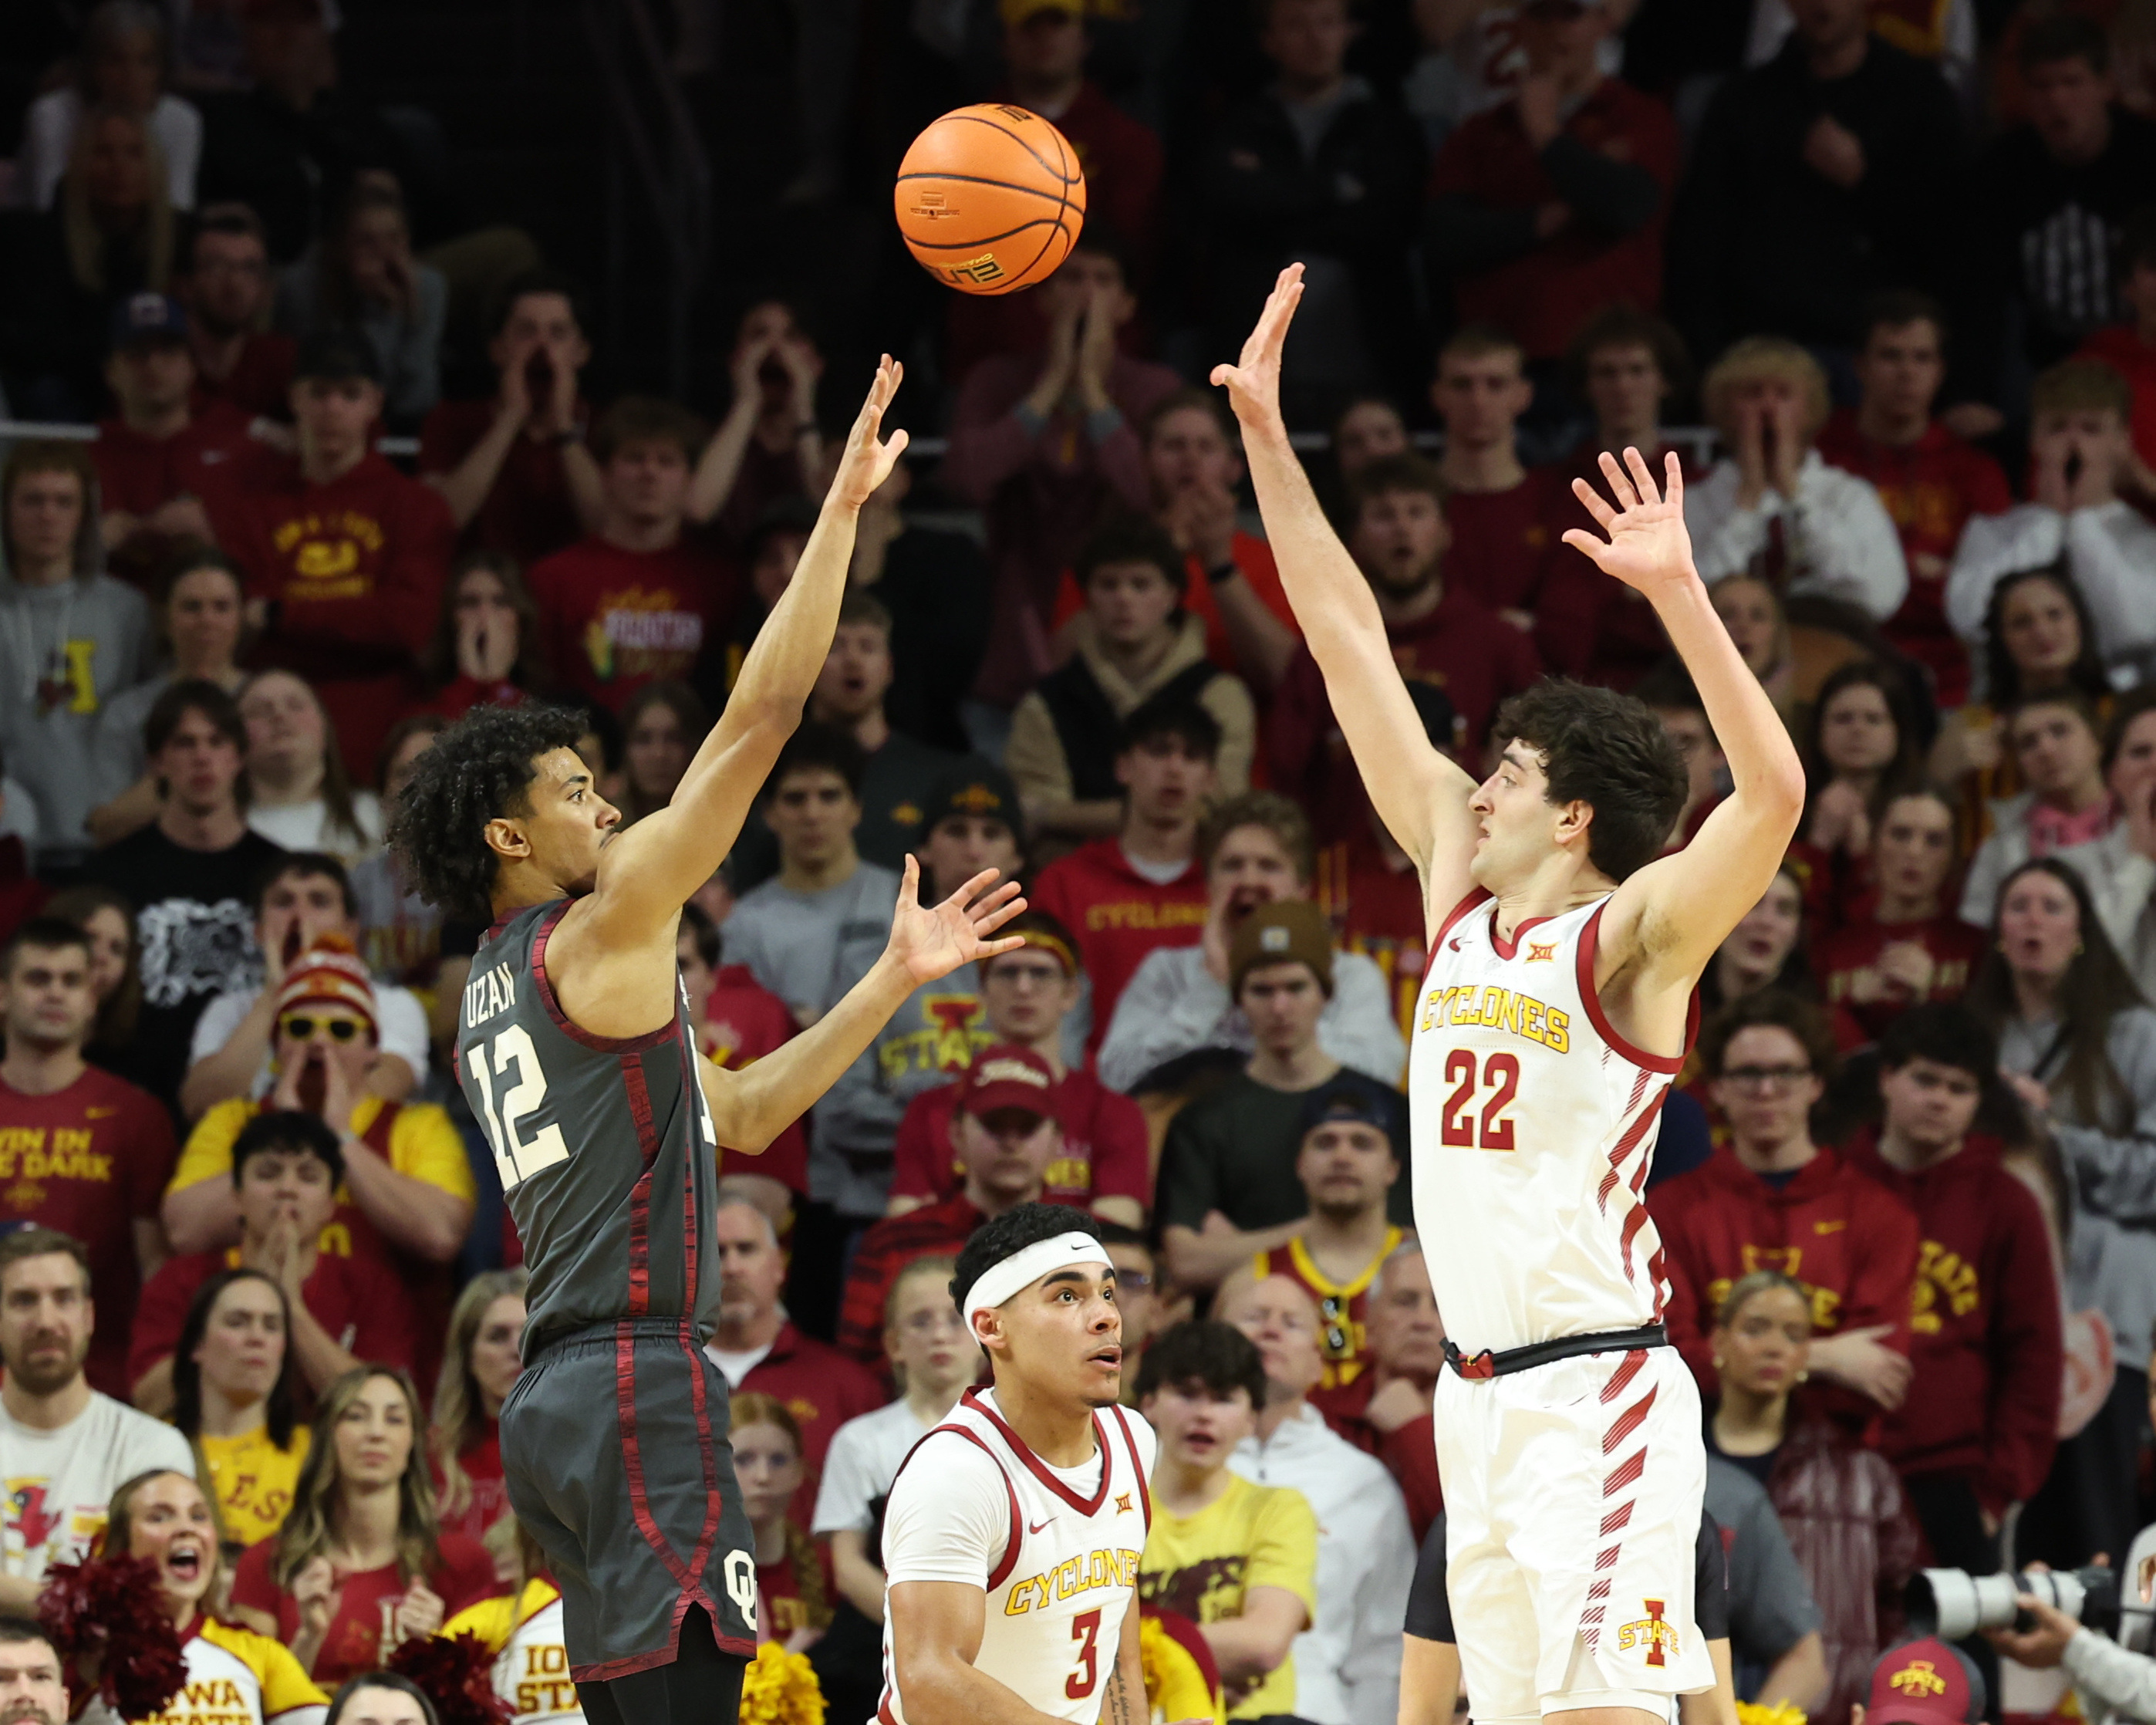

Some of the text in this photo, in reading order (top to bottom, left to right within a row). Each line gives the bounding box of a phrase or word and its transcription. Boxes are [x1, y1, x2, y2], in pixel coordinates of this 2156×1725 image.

[466, 961, 516, 1029] UZAN
[1422, 985, 1570, 1055] CYCLONES
[467, 1023, 570, 1193] 12
[1441, 1048, 1520, 1152] 22
[1065, 1607, 1102, 1700] 3
[1618, 1619, 1681, 1657] STATE
